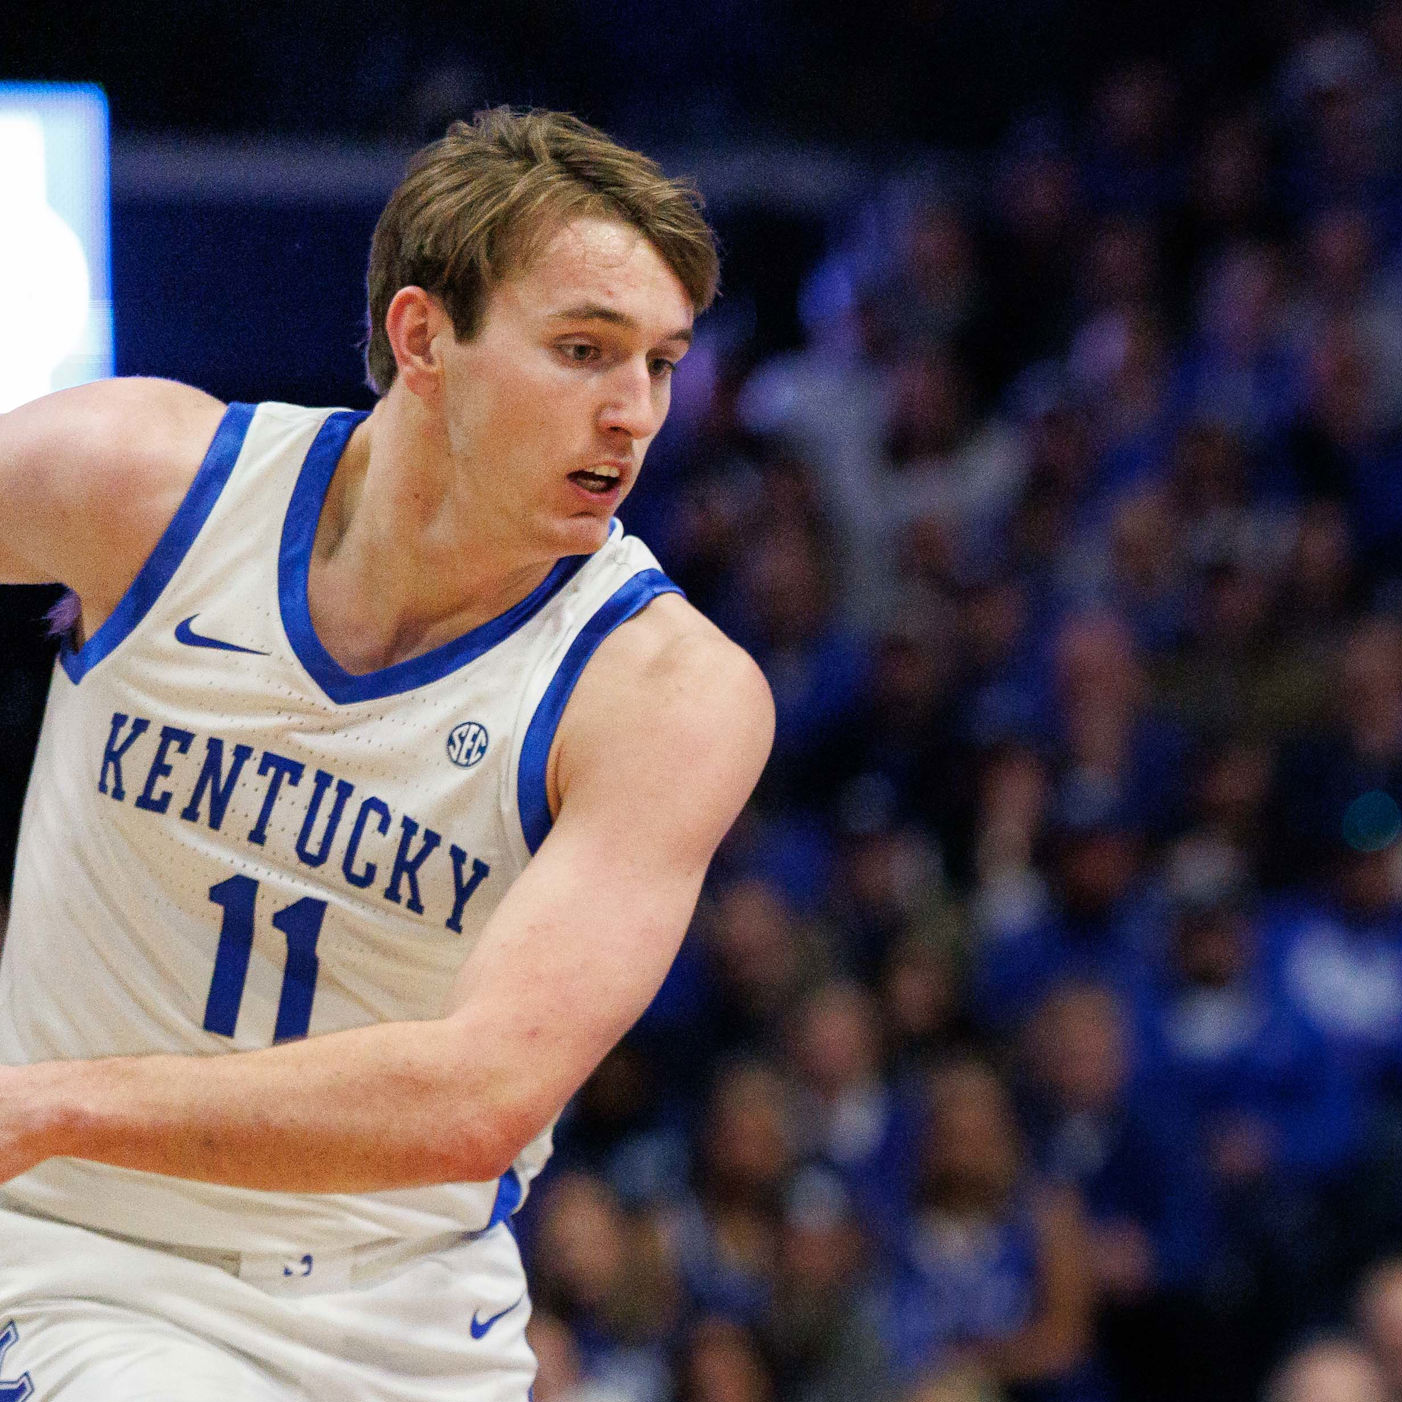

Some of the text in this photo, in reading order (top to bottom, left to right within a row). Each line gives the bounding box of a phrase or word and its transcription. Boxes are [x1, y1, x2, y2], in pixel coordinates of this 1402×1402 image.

[98, 712, 490, 935] KENTUCKY
[449, 725, 488, 766] SEC
[203, 873, 328, 1046] 11
